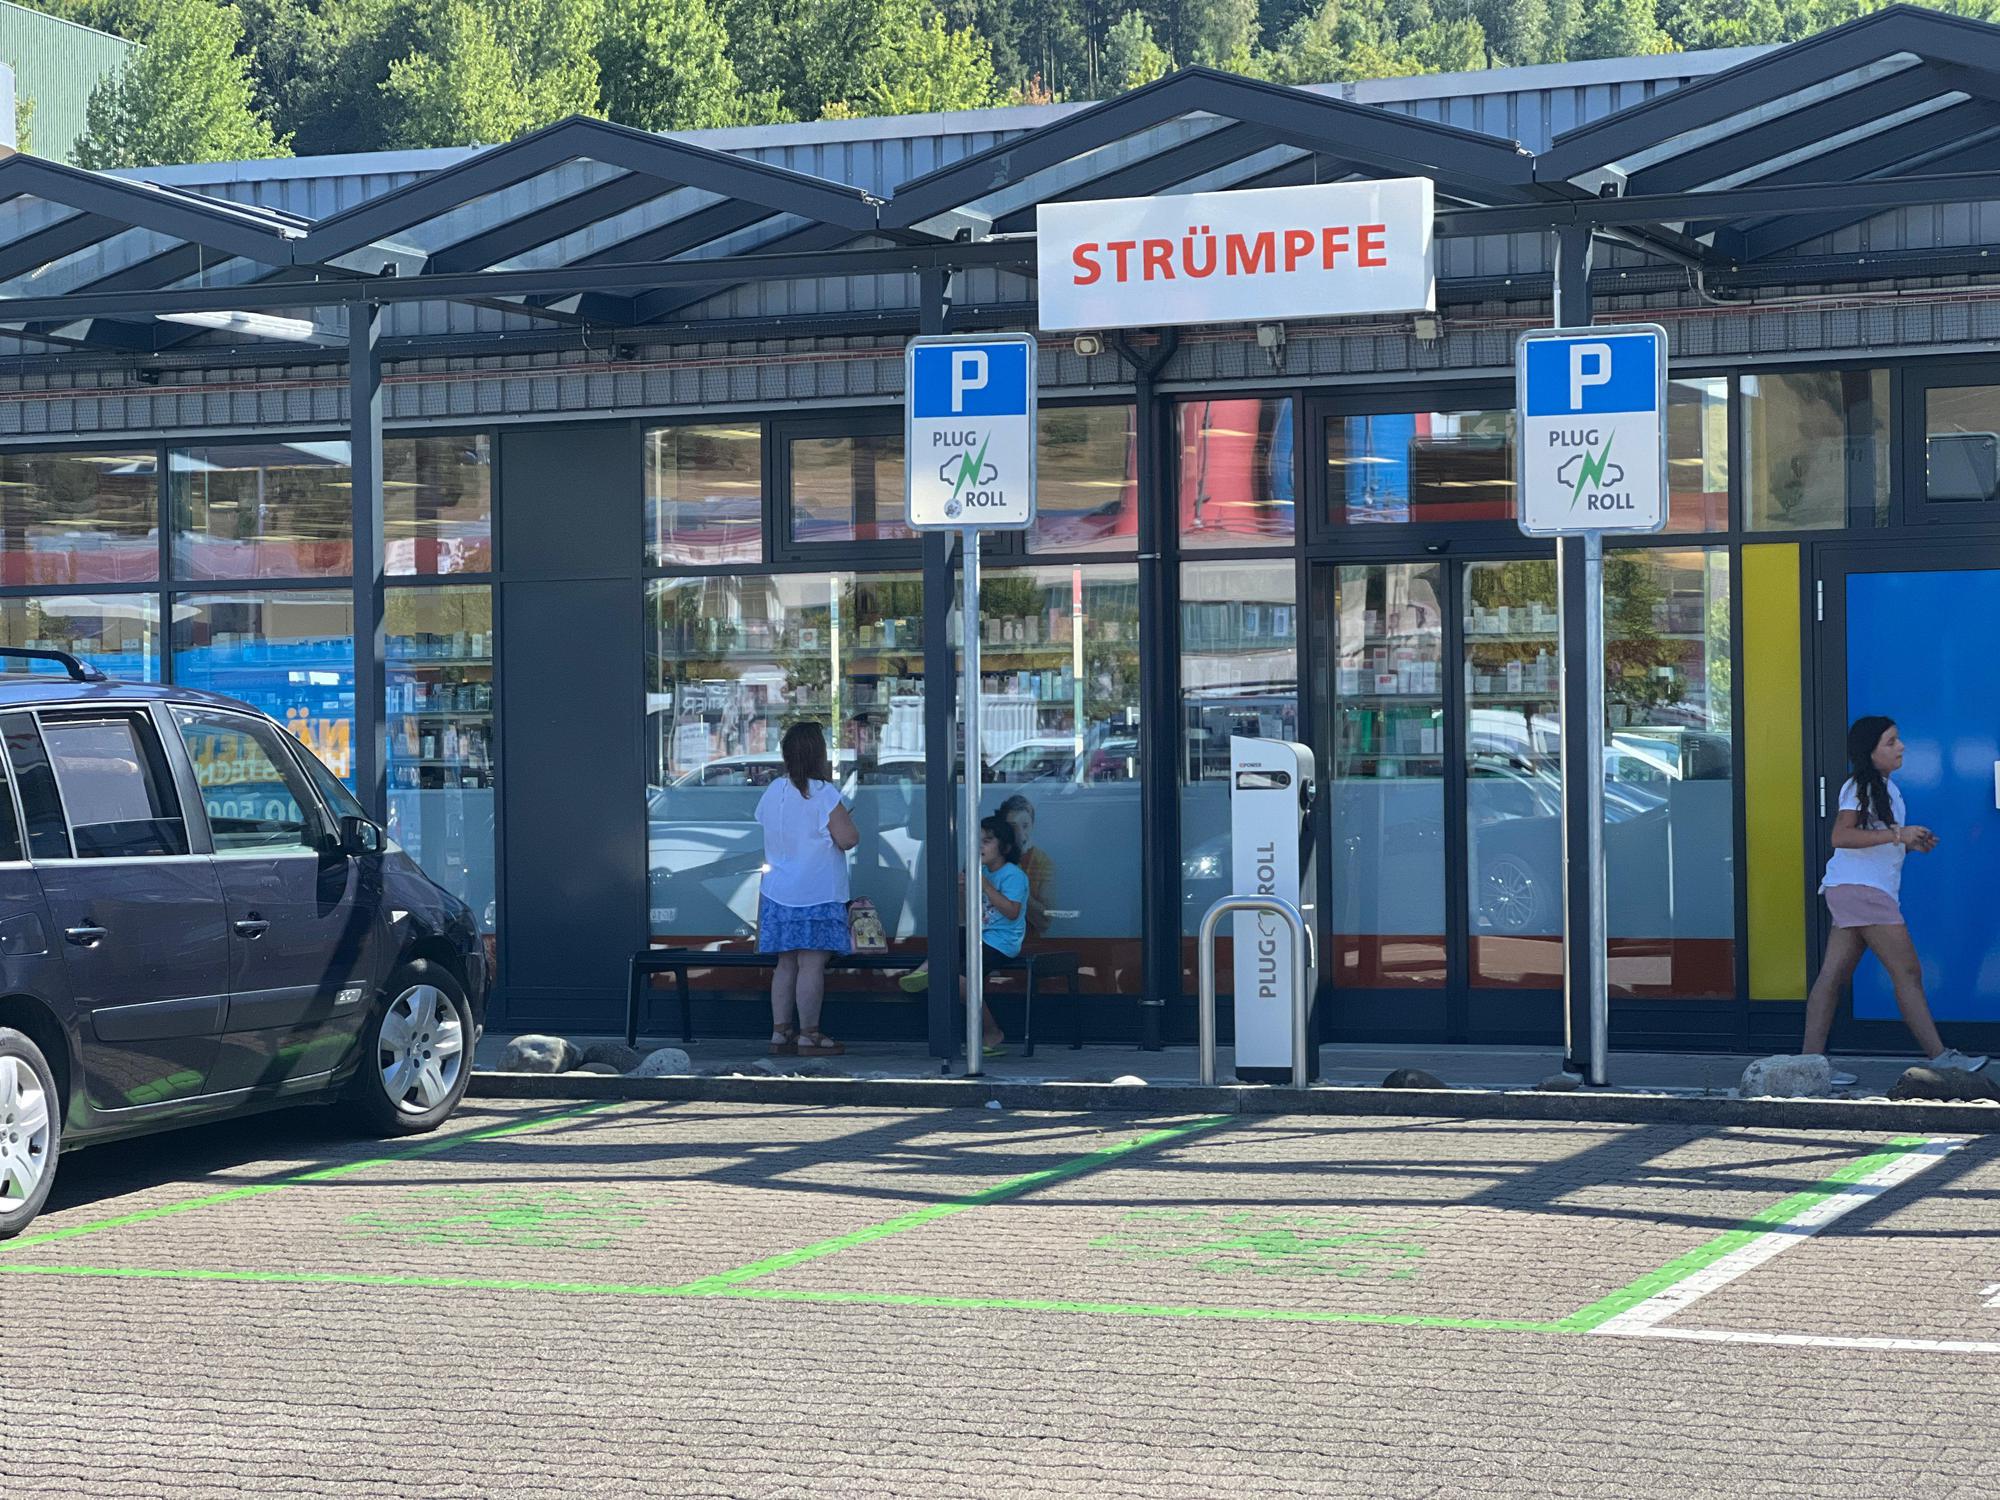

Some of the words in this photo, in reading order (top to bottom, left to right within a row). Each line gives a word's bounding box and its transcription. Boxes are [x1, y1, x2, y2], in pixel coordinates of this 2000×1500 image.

[1073, 224, 1387, 286] STRÜMPFE
[951, 350, 989, 412] P
[1569, 342, 1612, 410] P
[933, 431, 977, 447] PLUG
[1549, 429, 1599, 447] PLUG
[966, 491, 1007, 507] ROLL
[1587, 493, 1635, 511] ROLL
[1256, 841, 1275, 897] ROLL
[1258, 939, 1277, 998] PLUG
